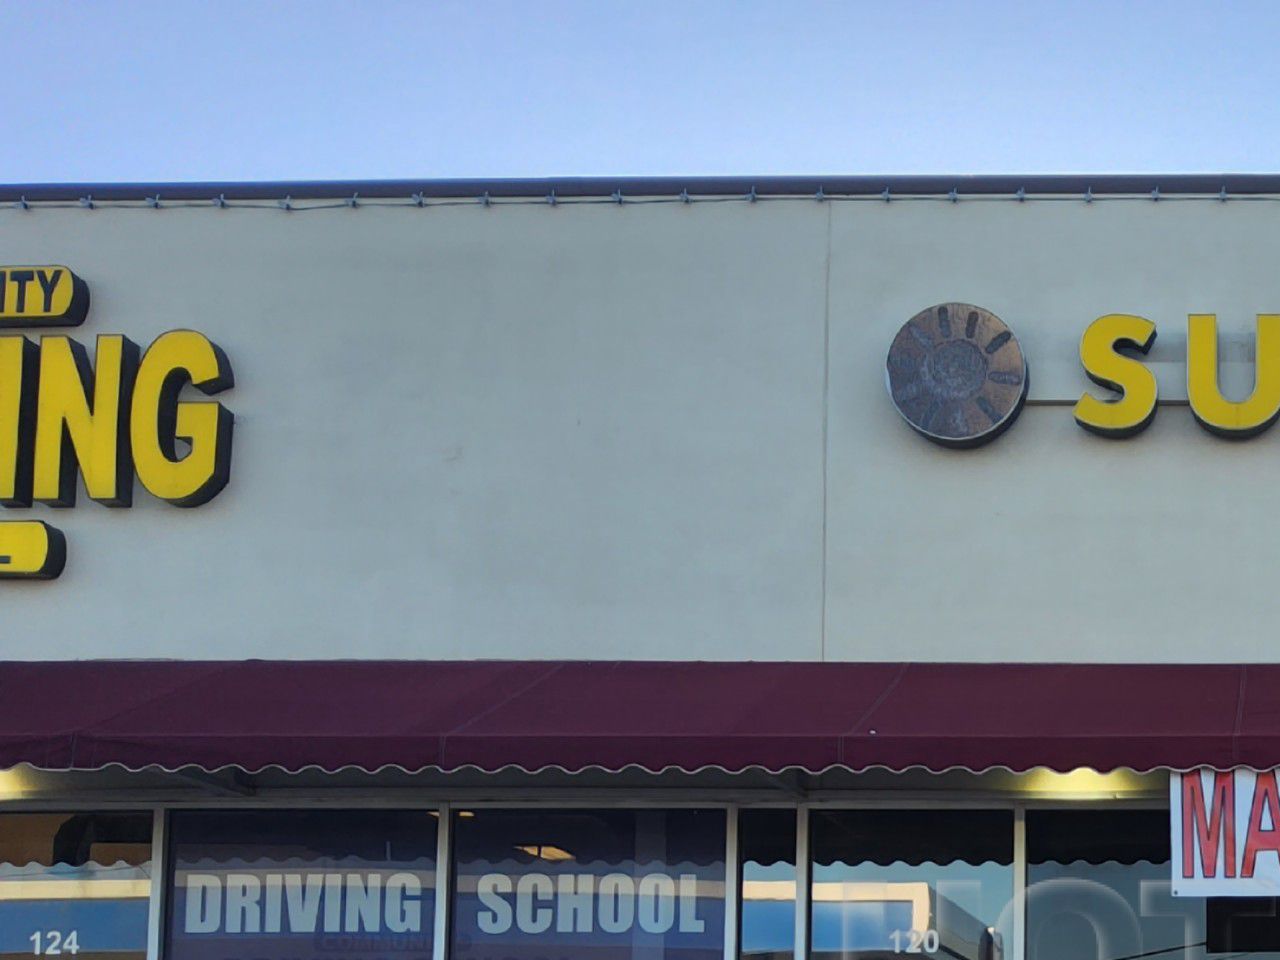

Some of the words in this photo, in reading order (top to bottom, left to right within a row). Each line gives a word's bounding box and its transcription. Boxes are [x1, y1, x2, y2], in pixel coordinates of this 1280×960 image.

[184, 873, 422, 934] DRIVING
[476, 873, 706, 935] SCHOOL
[29, 930, 80, 955] 124
[888, 929, 940, 954] 120
